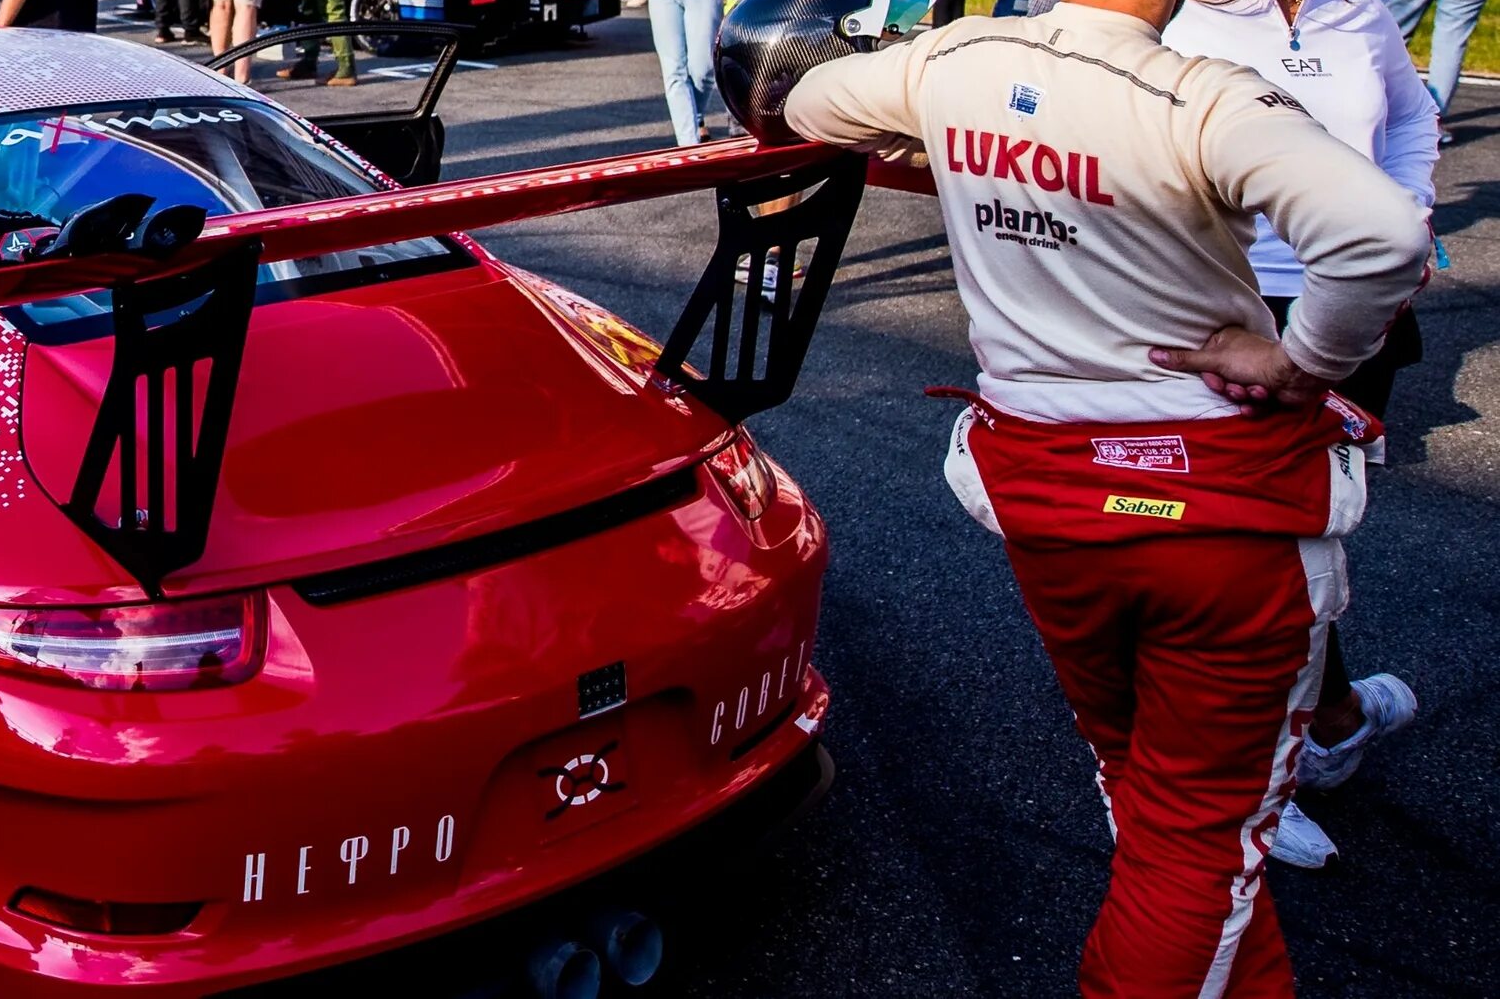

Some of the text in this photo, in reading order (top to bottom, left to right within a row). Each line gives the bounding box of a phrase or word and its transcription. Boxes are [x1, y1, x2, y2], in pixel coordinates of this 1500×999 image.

[1281, 58, 1323, 73] EA7
[946, 127, 1116, 207] LUKOIL
[995, 230, 1061, 251] energy drink
[1112, 498, 1176, 517] Sabelt
[243, 814, 455, 902] НЕФРО
